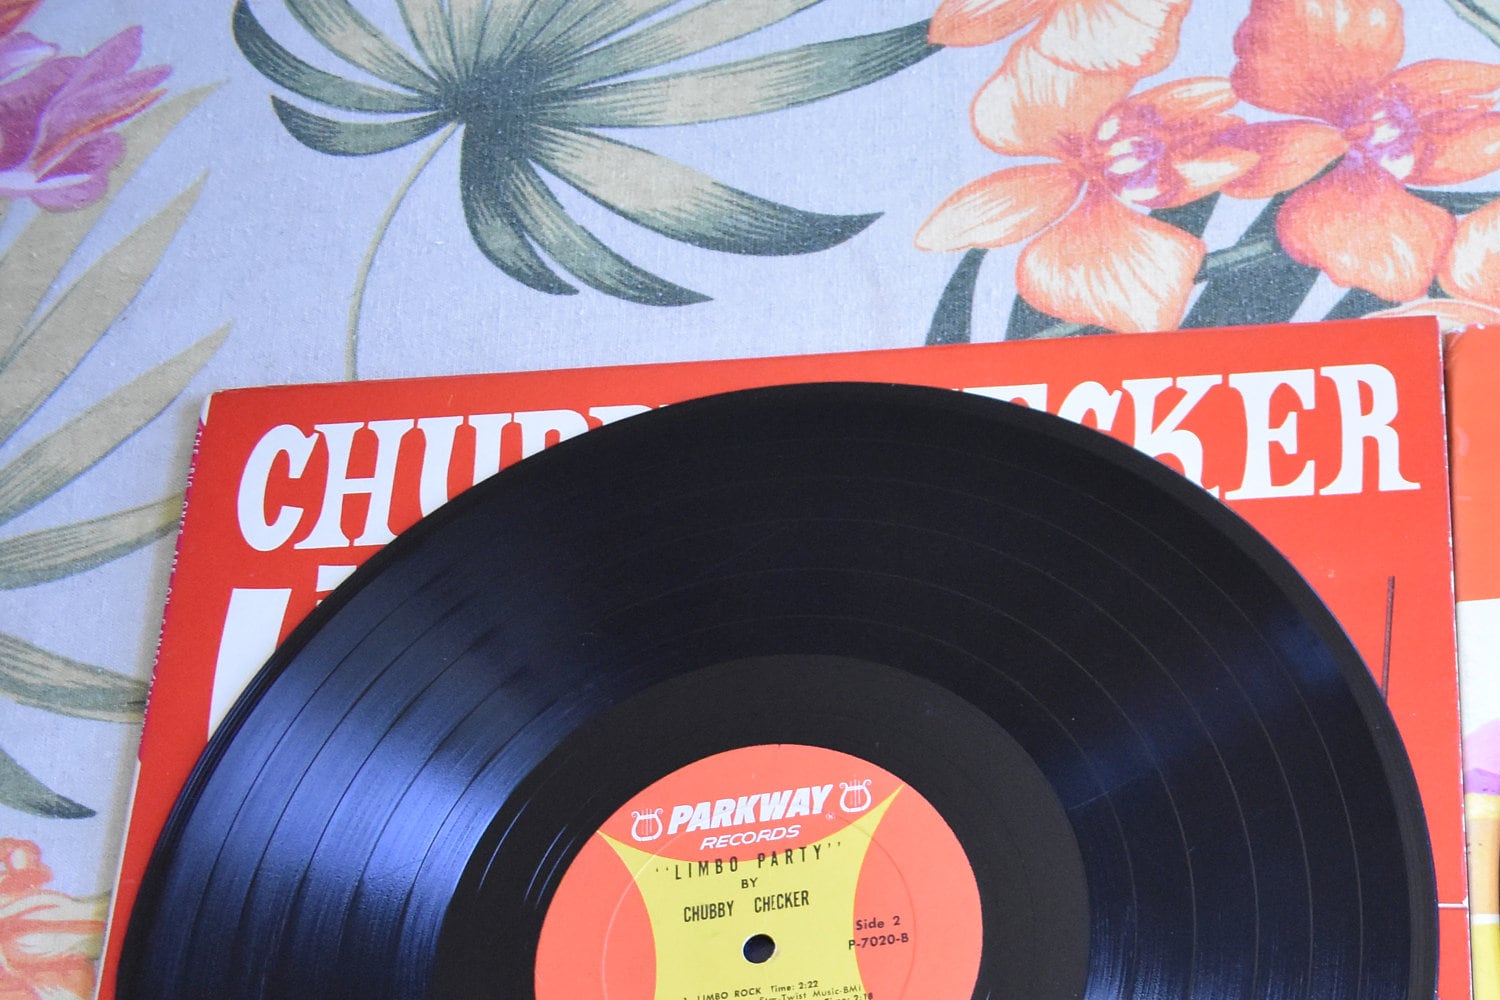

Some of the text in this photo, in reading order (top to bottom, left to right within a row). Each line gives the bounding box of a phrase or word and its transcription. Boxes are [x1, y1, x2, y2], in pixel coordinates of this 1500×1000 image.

[237, 404, 684, 551] CHU
[666, 784, 833, 834] PARKWAY
[700, 825, 801, 850] RECORDS
[740, 877, 758, 889] BY
[683, 890, 809, 922] CHUBBY CHECKER
[855, 915, 900, 930] Side 2
[848, 933, 909, 949] P-7020-B
[734, 987, 761, 998] ROCK
[770, 983, 794, 993] Time:
[798, 980, 818, 989] 2:22
